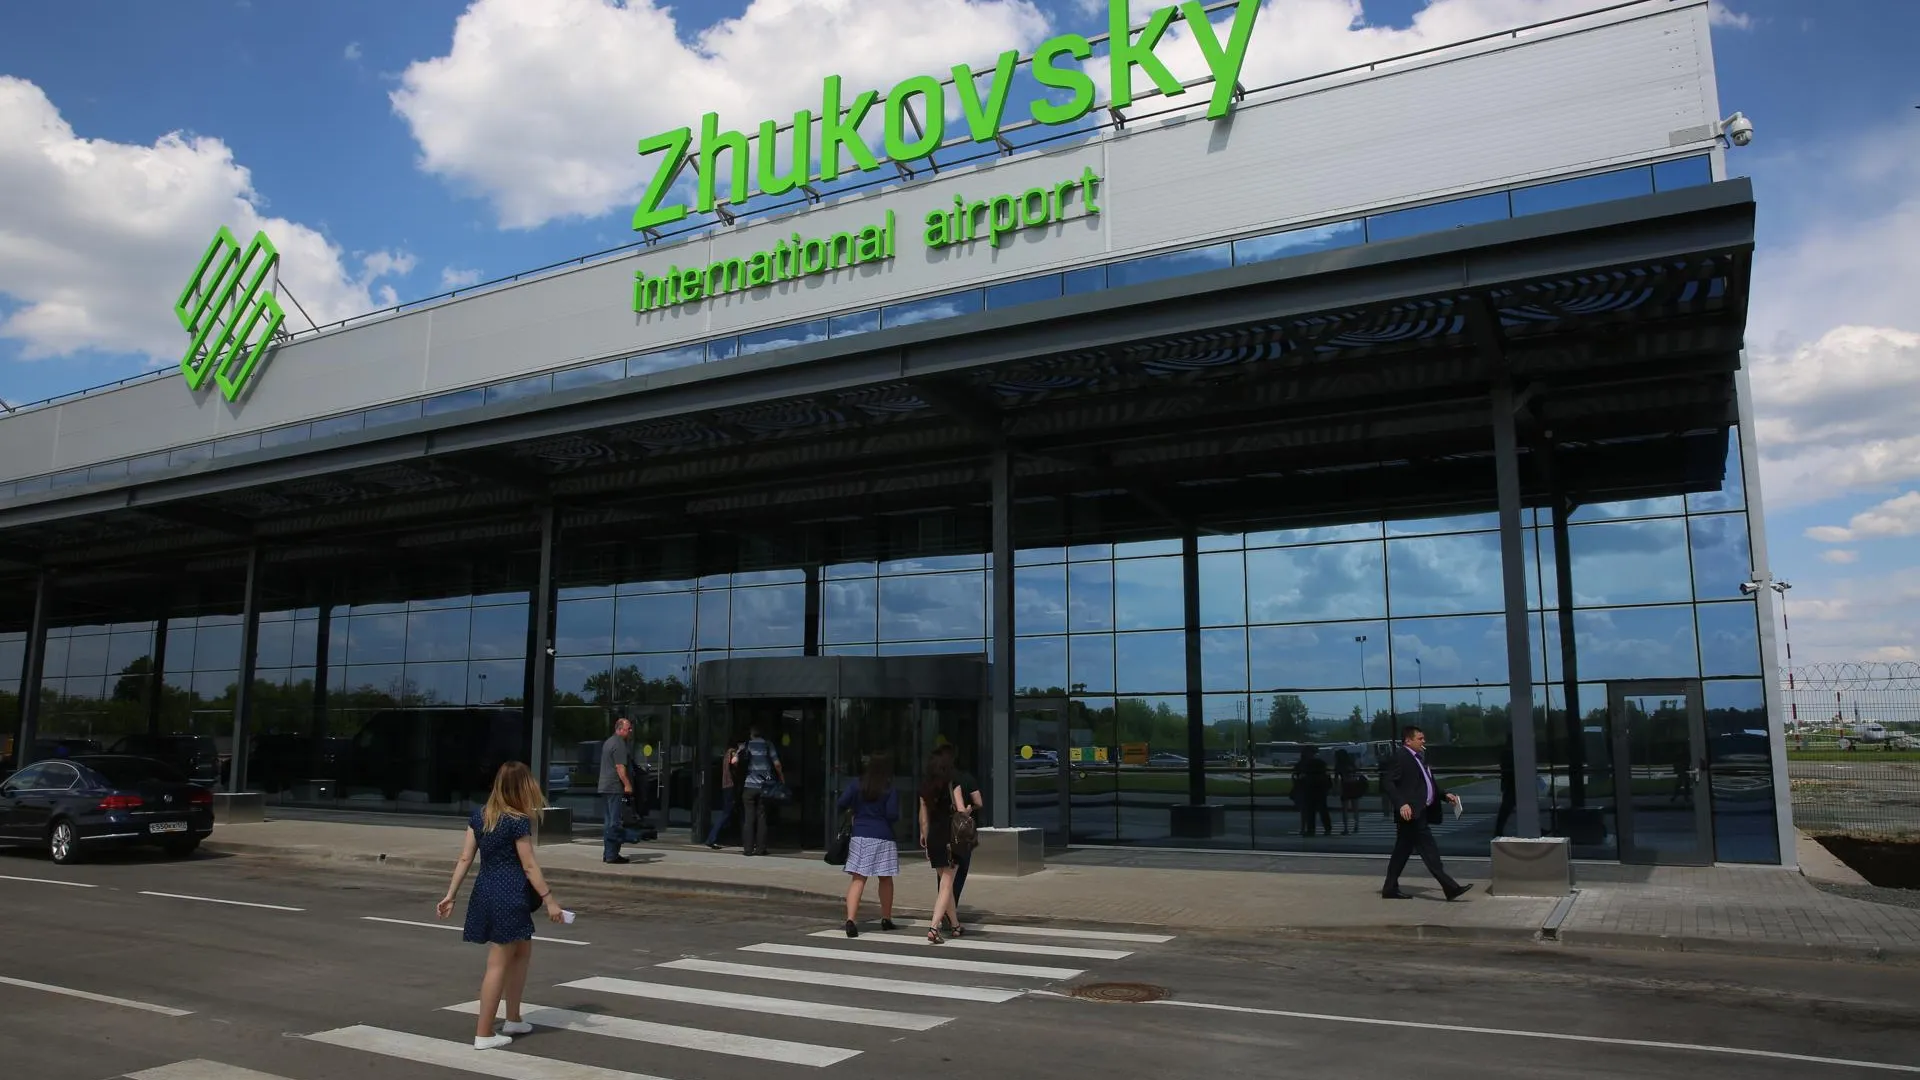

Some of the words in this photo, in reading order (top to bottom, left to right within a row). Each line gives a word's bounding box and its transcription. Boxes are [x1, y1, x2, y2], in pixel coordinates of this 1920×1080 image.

[631, 0, 1261, 231] Zhukovsky
[632, 209, 896, 313] international
[923, 167, 1102, 248] airport
